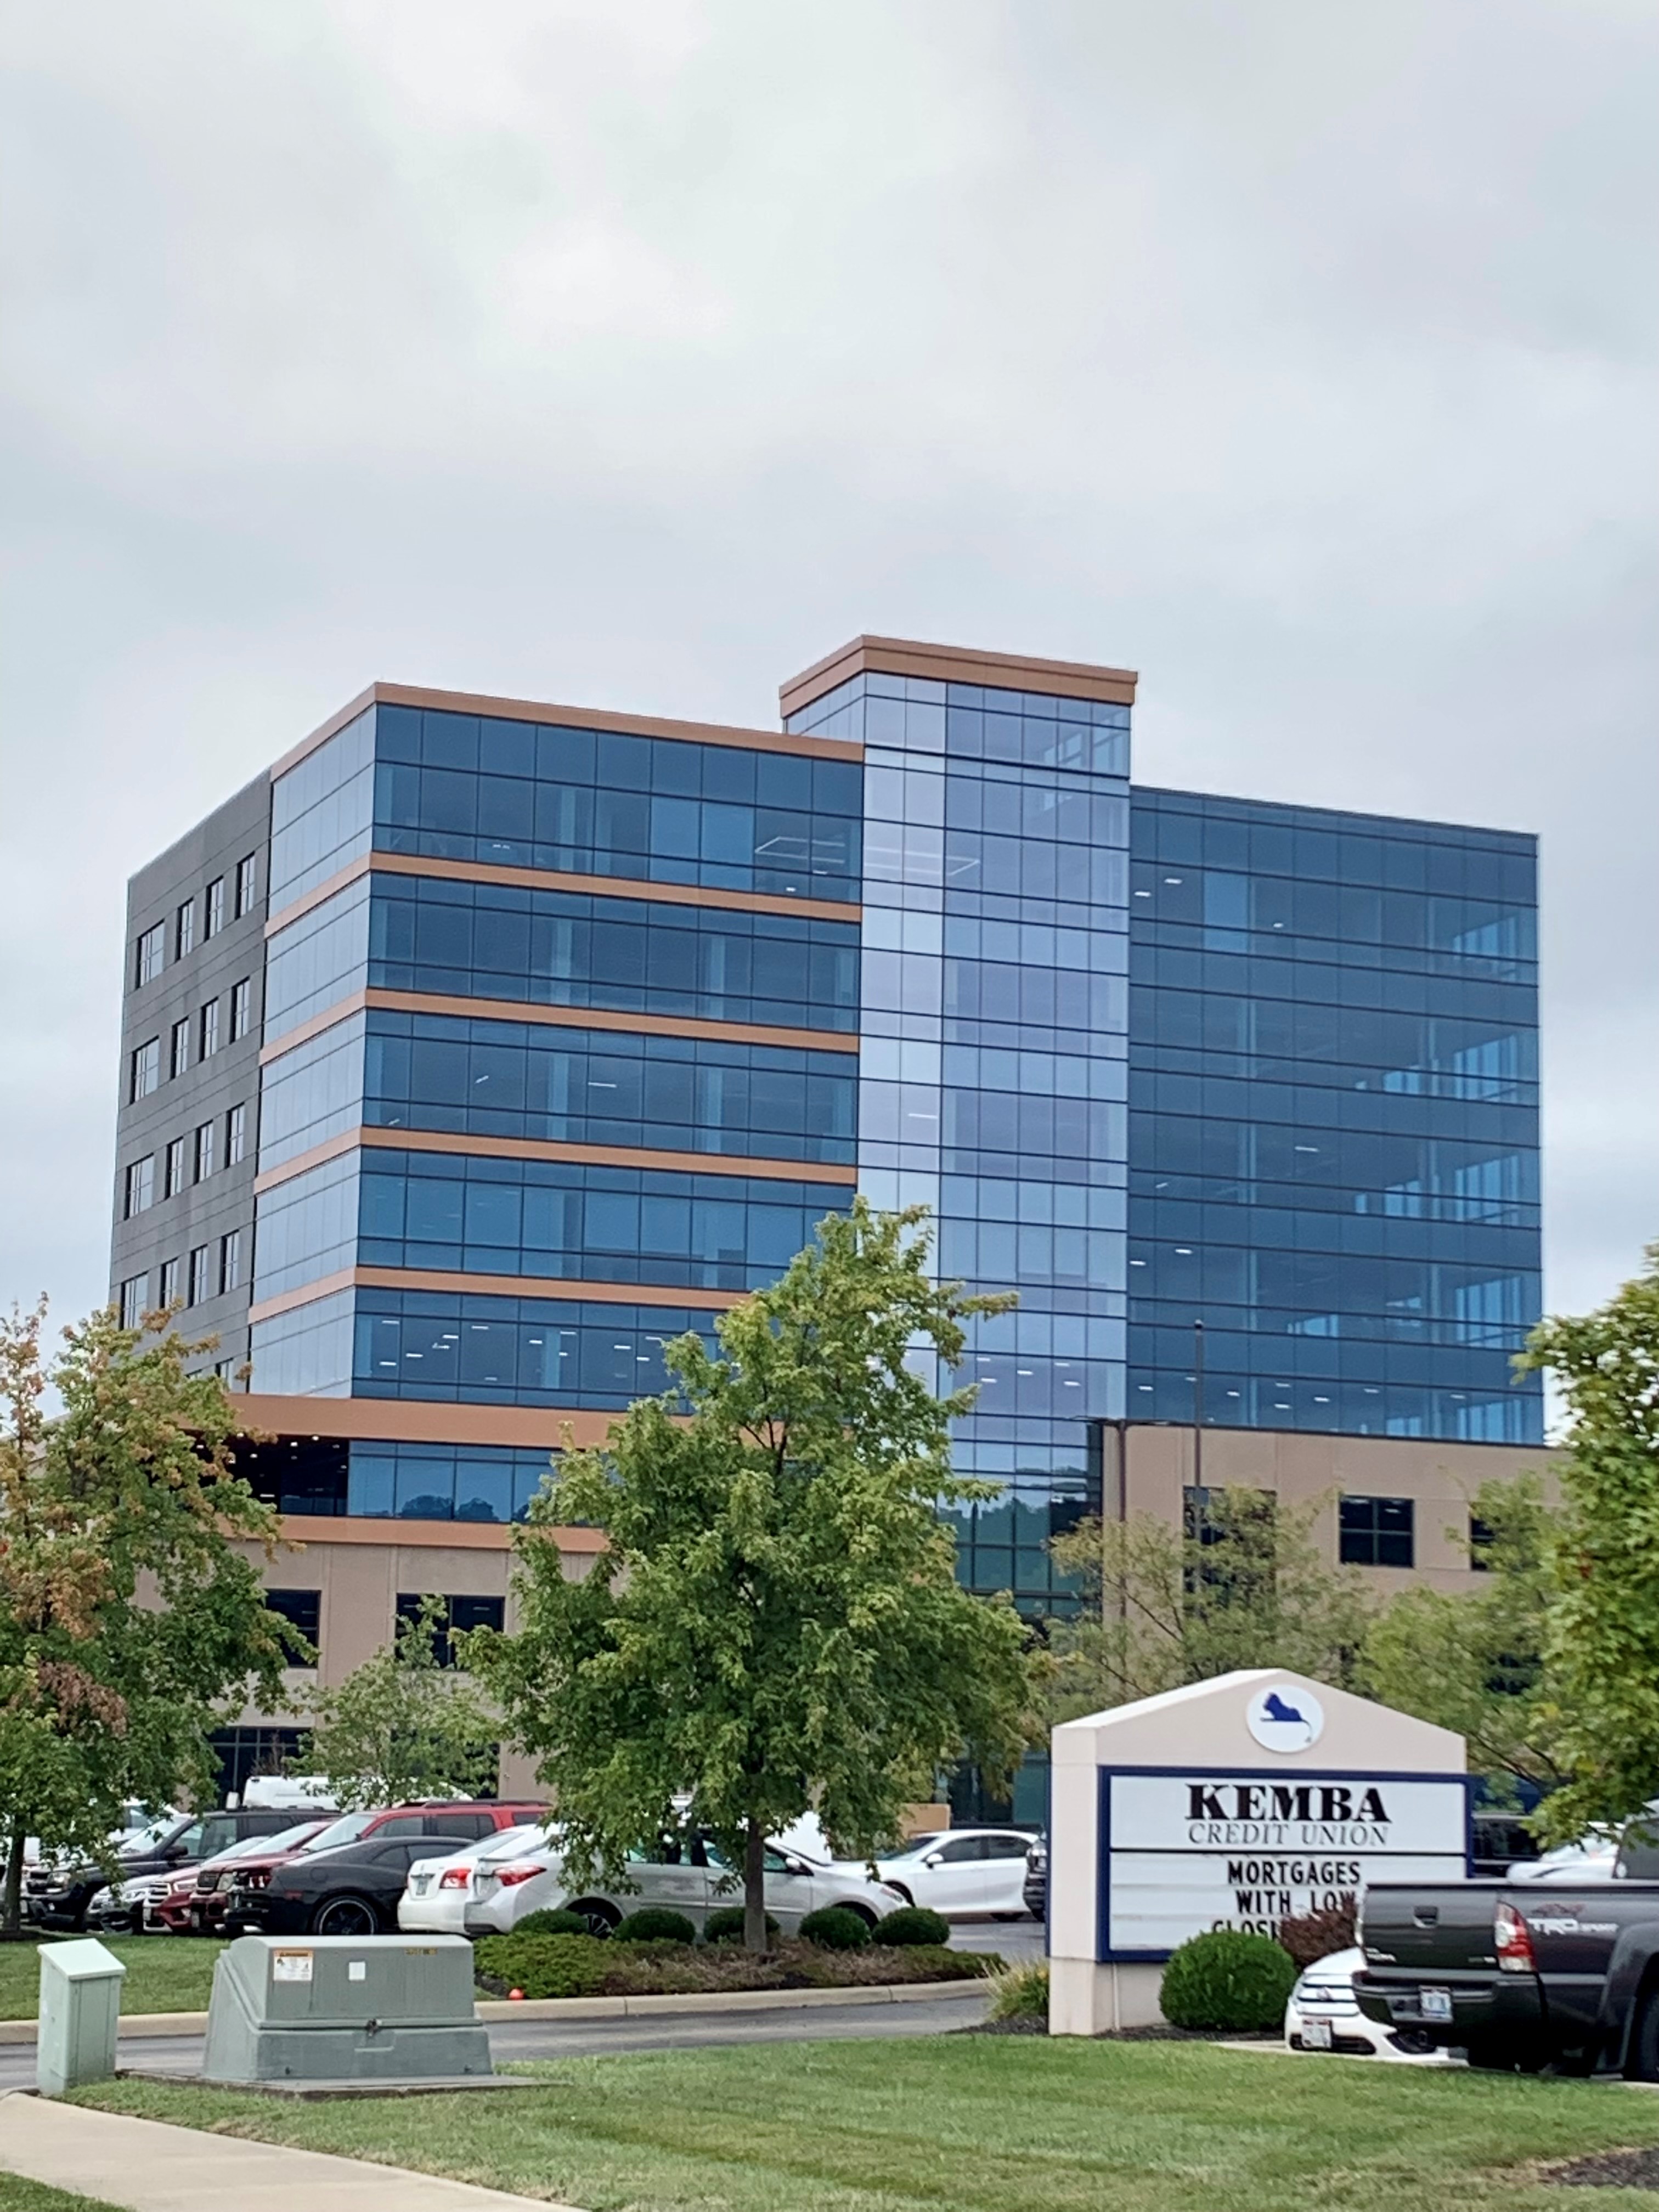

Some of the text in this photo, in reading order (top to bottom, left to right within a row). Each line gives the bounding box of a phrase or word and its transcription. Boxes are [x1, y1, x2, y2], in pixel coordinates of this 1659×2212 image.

[1185, 1783, 1392, 1824] KEMBA
[1188, 1822, 1388, 1847] CREDIT UNION
[1227, 1860, 1361, 1885] MORTGAGES
[1235, 1890, 1290, 1915] WITH
